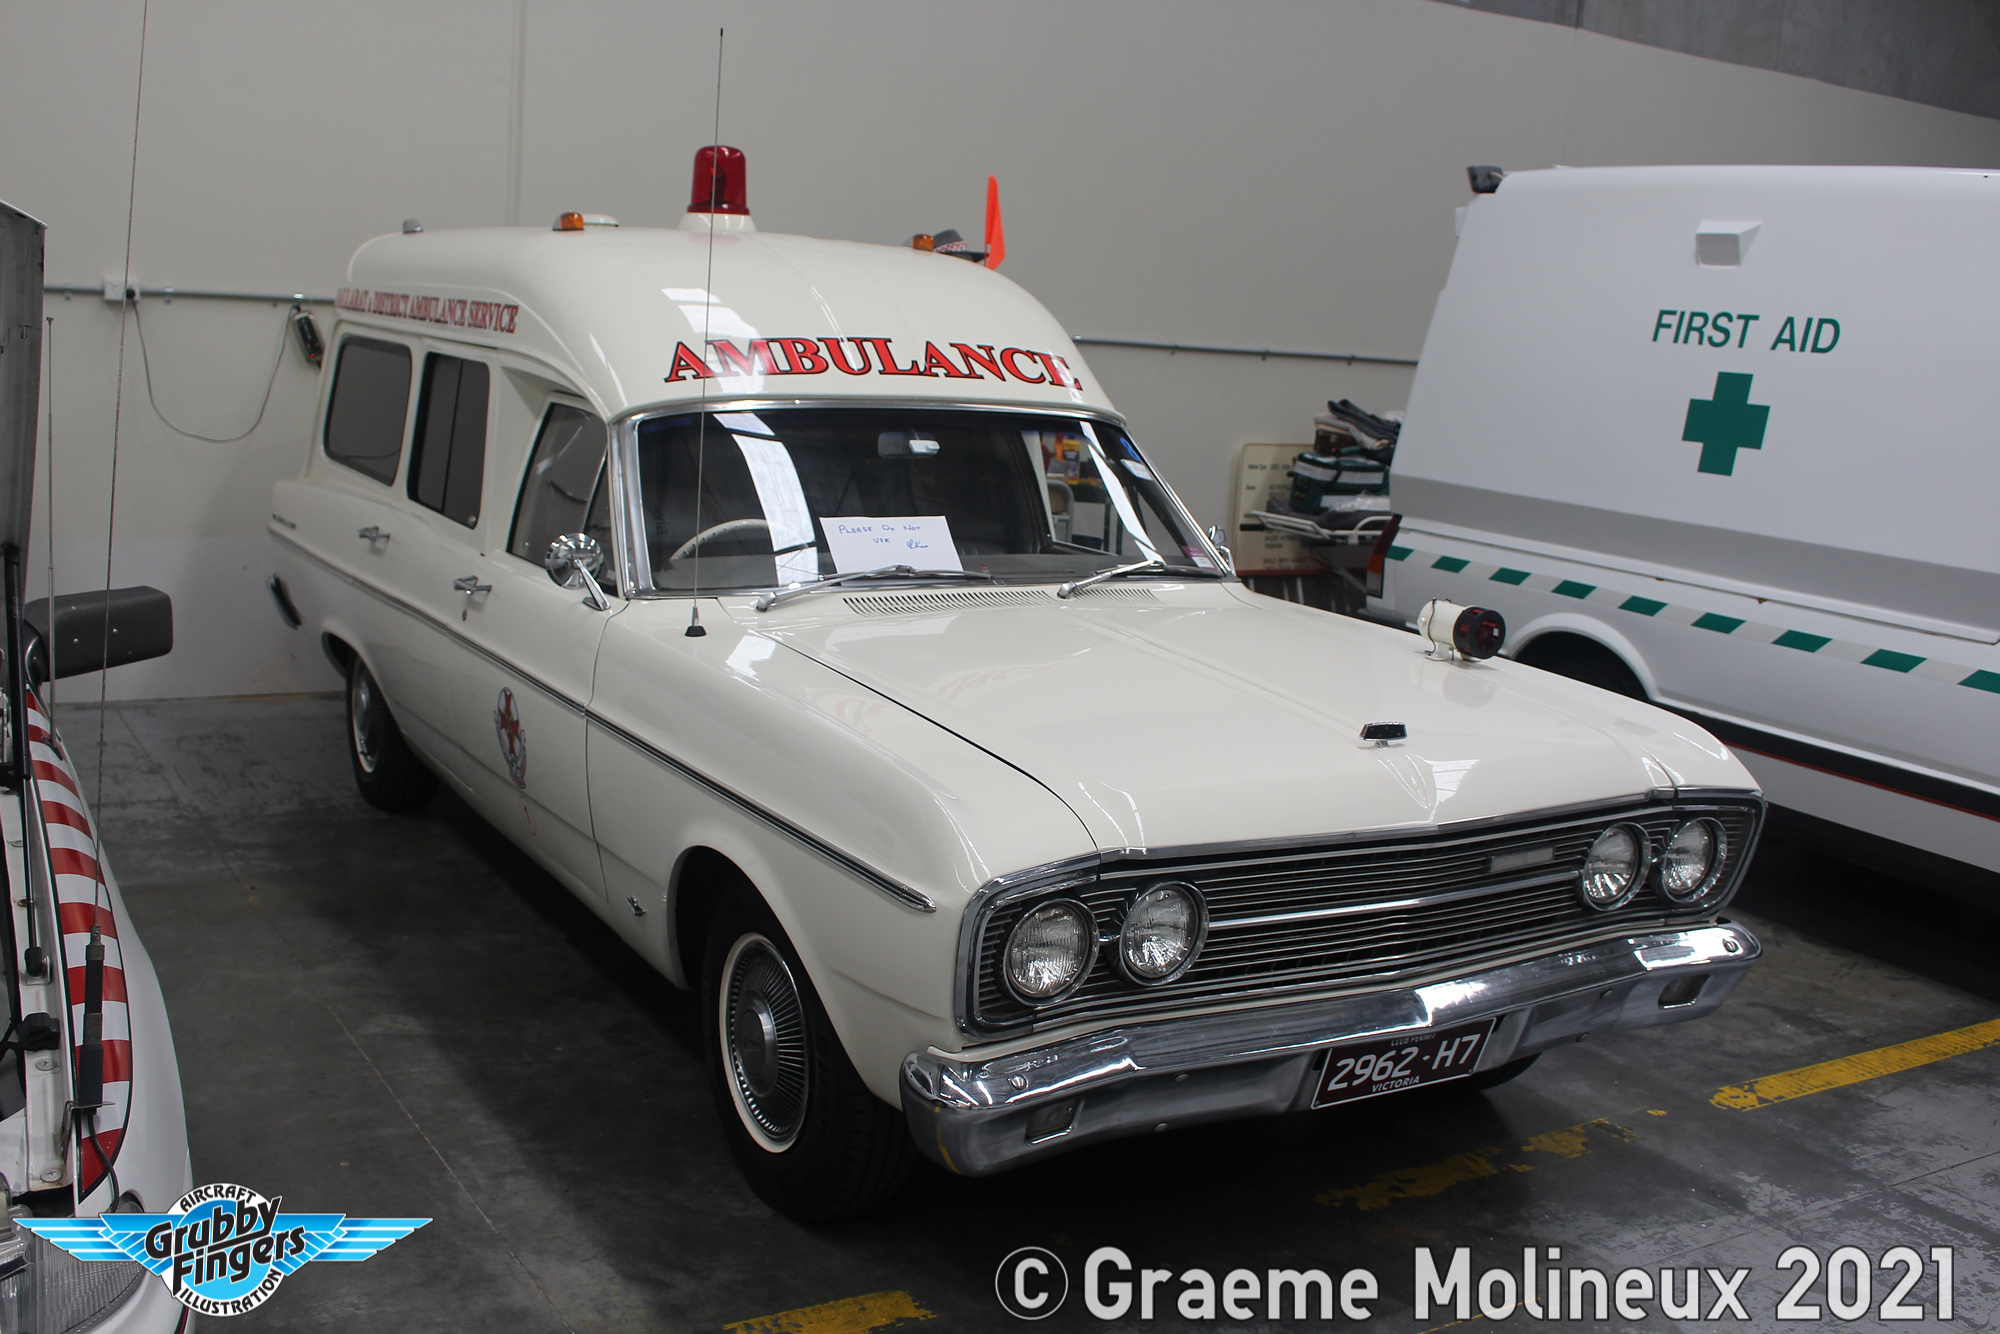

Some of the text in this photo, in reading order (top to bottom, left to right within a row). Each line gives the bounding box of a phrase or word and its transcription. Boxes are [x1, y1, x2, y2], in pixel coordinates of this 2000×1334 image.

[409, 295, 467, 326] AMBULANCE
[468, 301, 519, 333] SERVICE
[1652, 309, 1841, 354] FIRST AID
[663, 336, 1083, 391] AMBULANCE
[1372, 1075, 1420, 1093] VICTORIA
